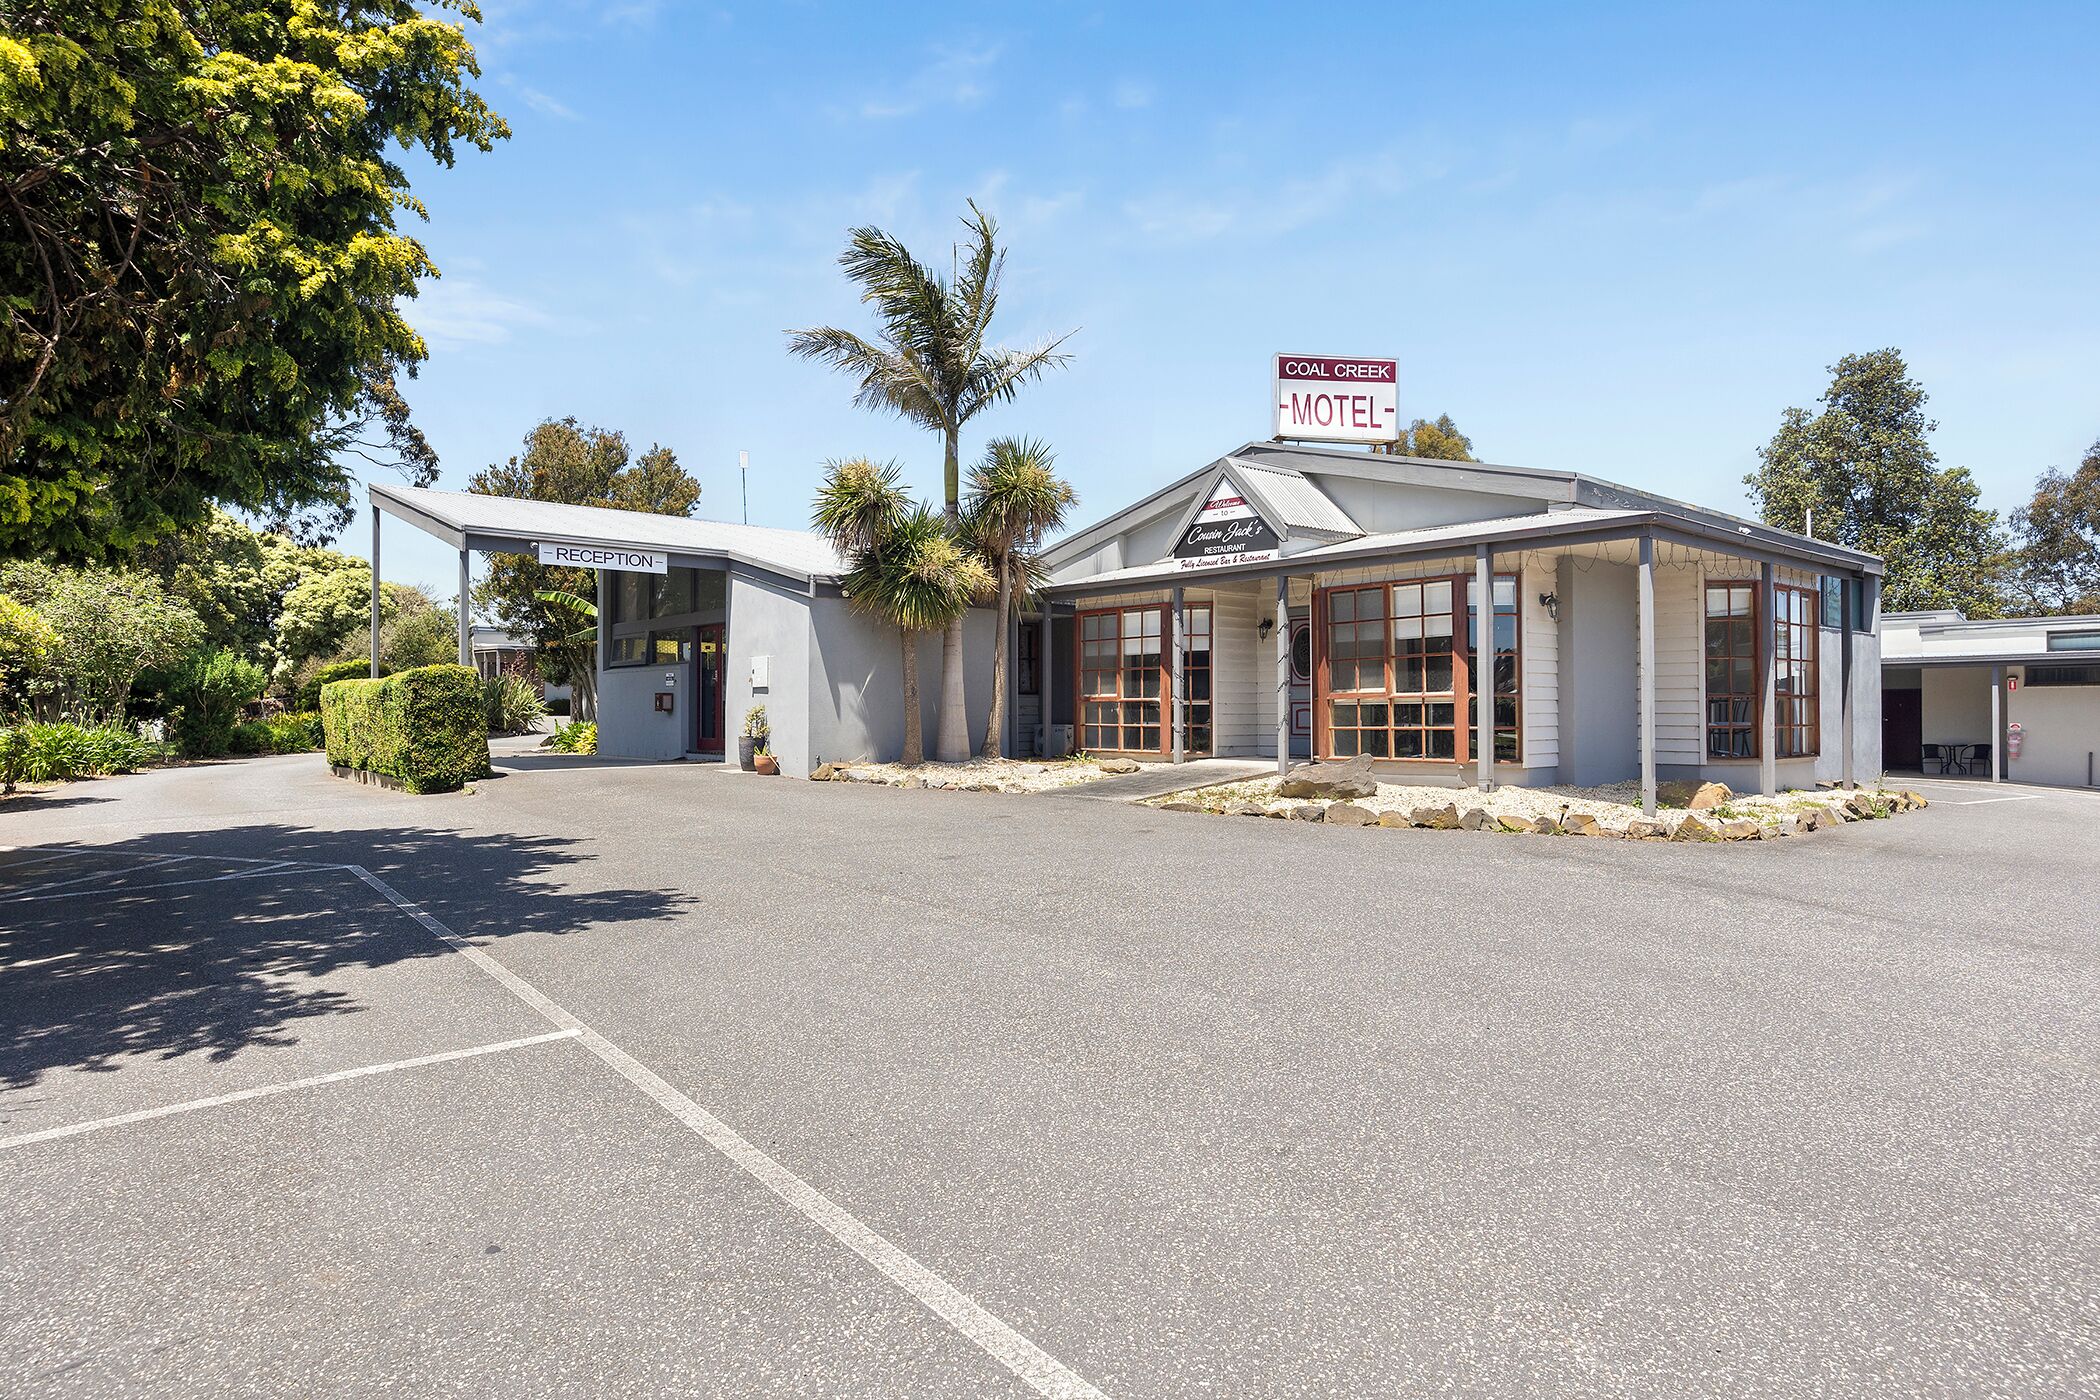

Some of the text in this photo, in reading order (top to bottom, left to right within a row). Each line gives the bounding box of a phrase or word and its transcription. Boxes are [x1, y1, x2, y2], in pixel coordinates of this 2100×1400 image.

[1285, 361, 1390, 379] COAL CREEK
[1209, 499, 1241, 509] Welcome
[1187, 520, 1263, 545] Cousin Jack's
[556, 547, 653, 568] RECEPTION
[1204, 543, 1246, 555] RESTAURANT
[1180, 560, 1195, 570] Fully
[1195, 558, 1219, 567] Licensed
[1220, 556, 1231, 565] Bar
[1238, 553, 1271, 563] Restaurant
